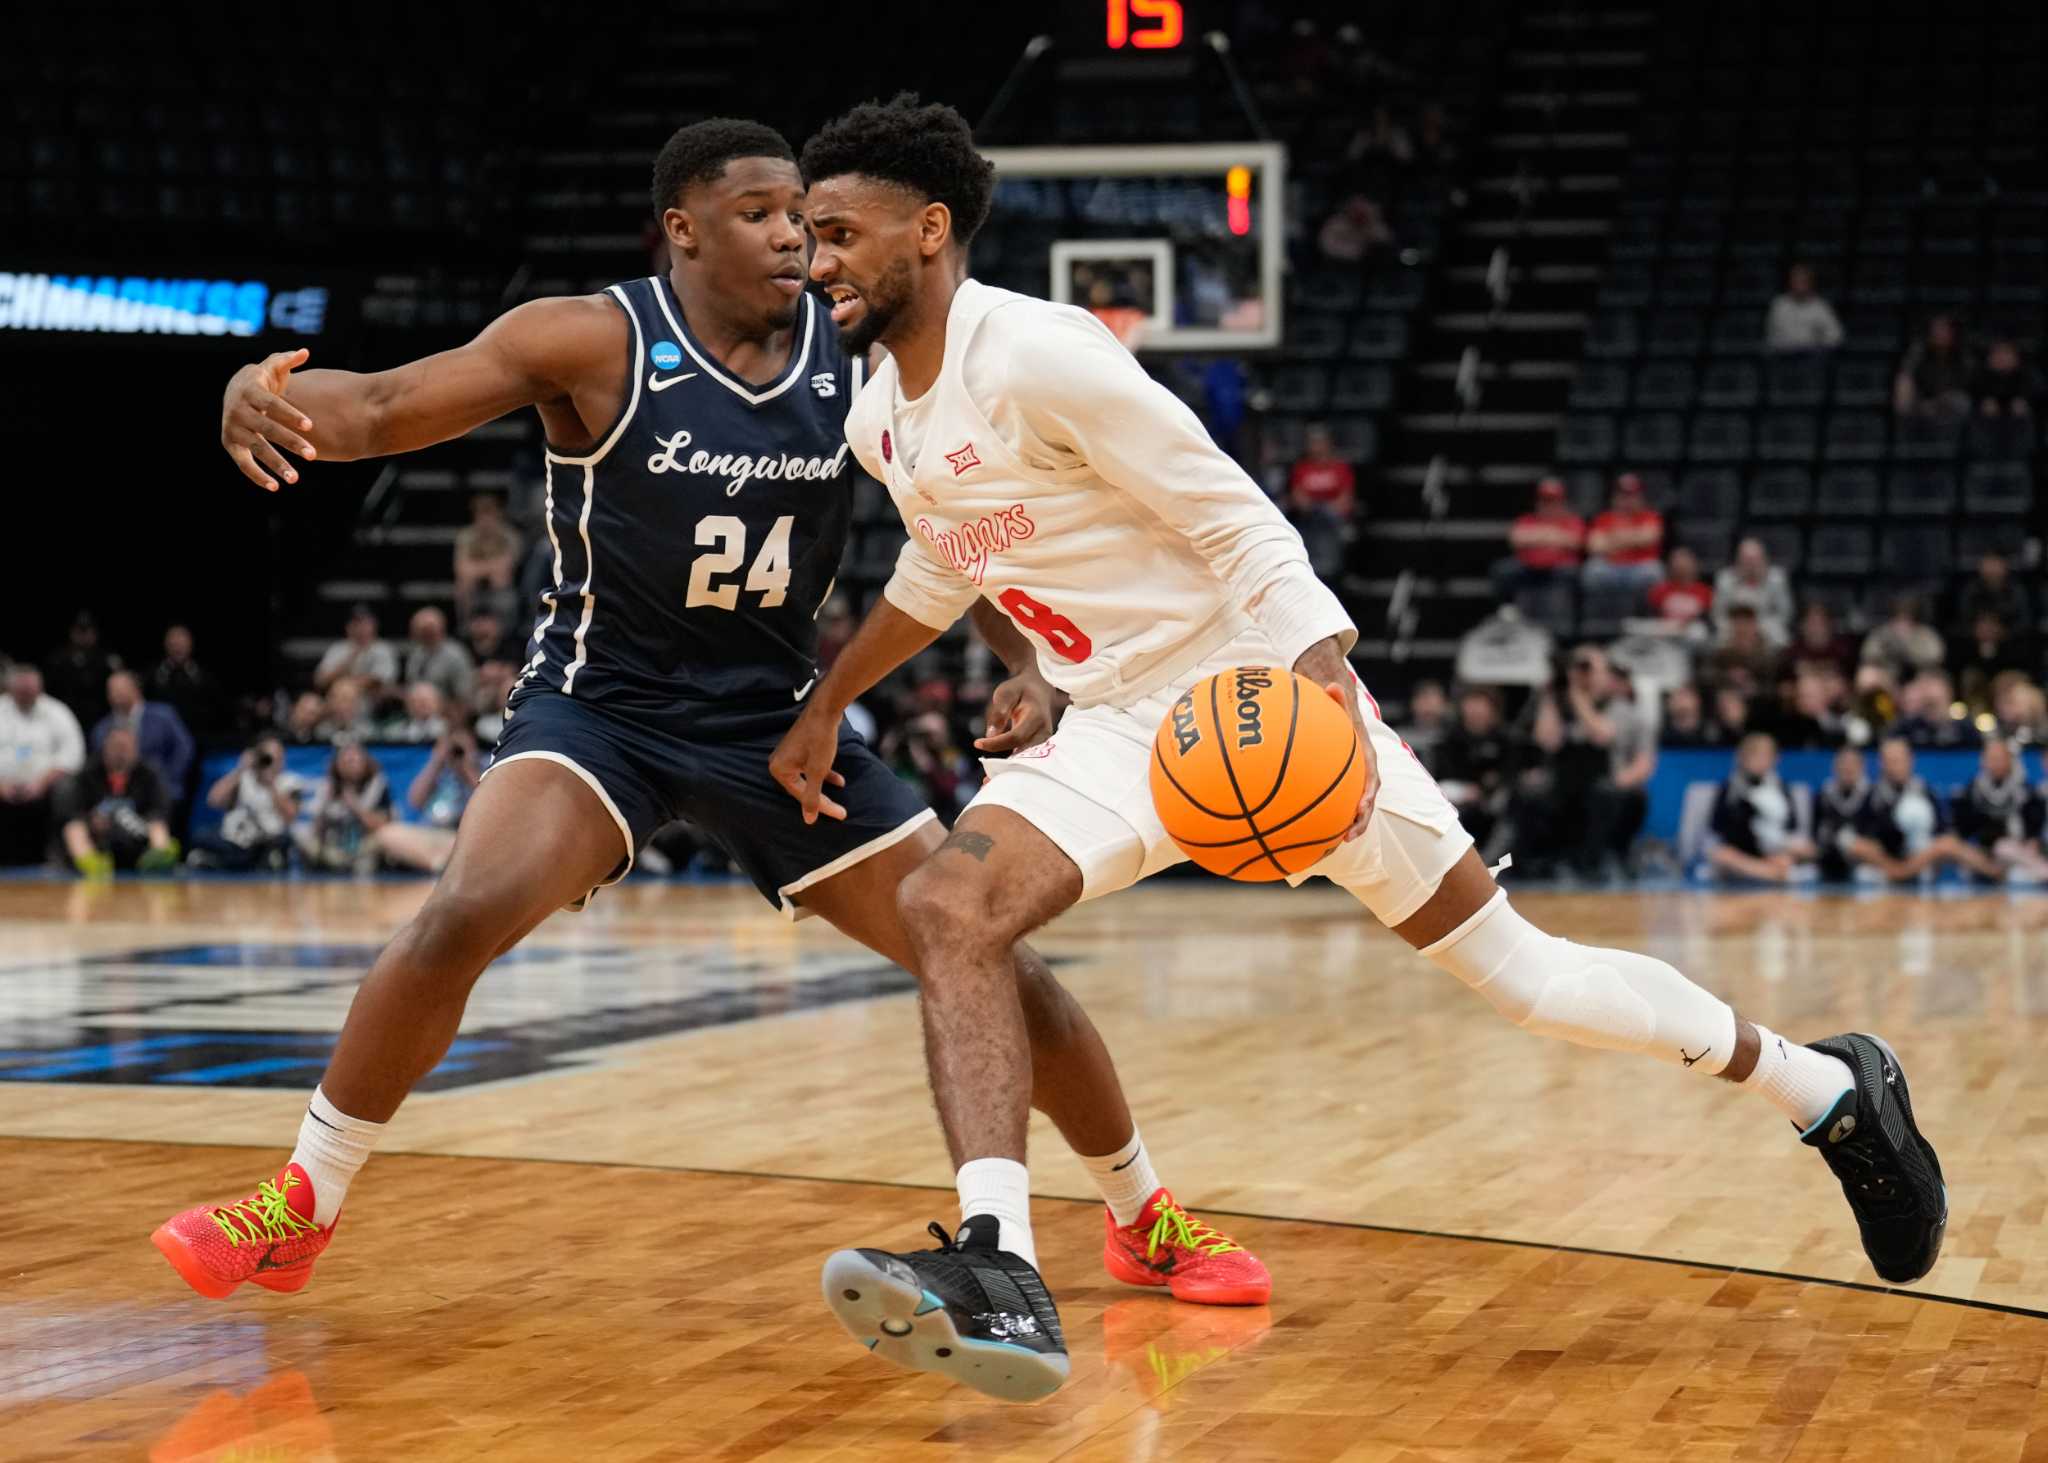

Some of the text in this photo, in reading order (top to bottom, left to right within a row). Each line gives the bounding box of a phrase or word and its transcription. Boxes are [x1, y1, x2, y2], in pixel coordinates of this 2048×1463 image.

[1106, 0, 1183, 48] 15
[648, 430, 848, 497] Longwood
[685, 515, 795, 612] 24
[998, 587, 1092, 664] 8
